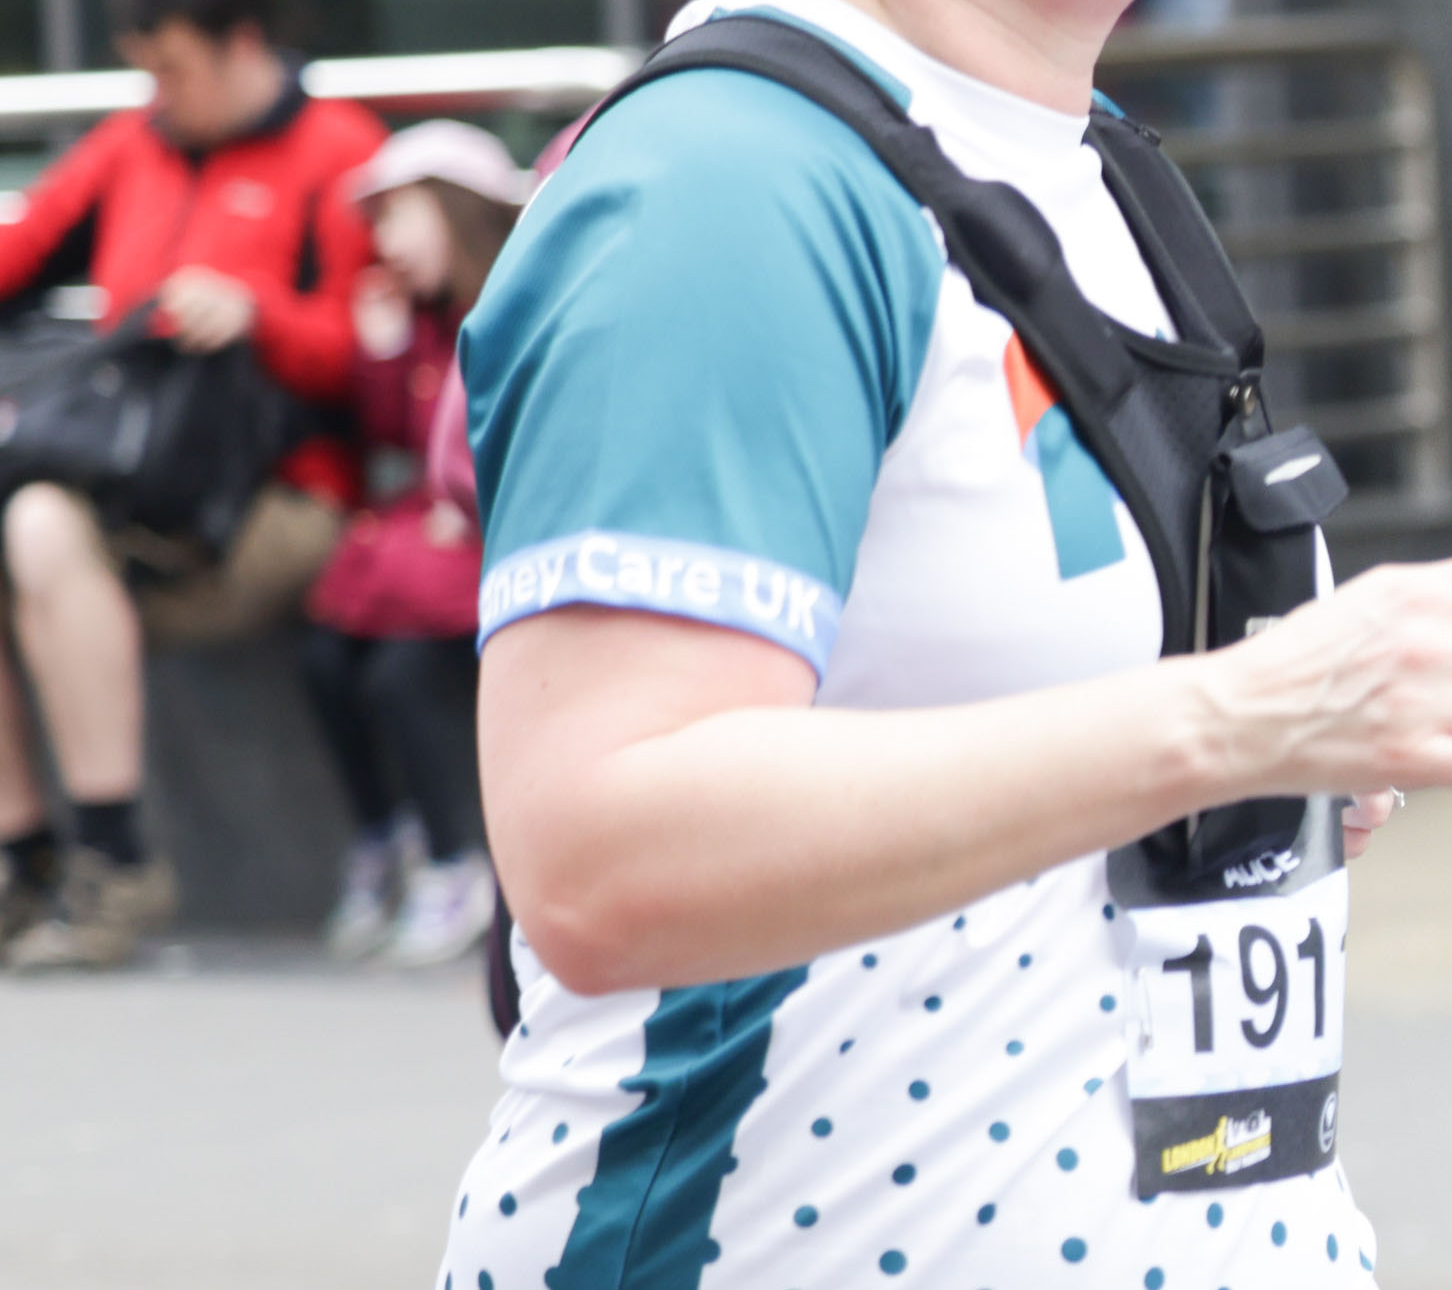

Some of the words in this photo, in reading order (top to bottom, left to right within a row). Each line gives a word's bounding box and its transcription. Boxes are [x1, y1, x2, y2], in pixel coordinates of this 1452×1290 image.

[576, 535, 721, 606] Care
[742, 561, 822, 639] UK
[1162, 917, 1348, 1053] 191
